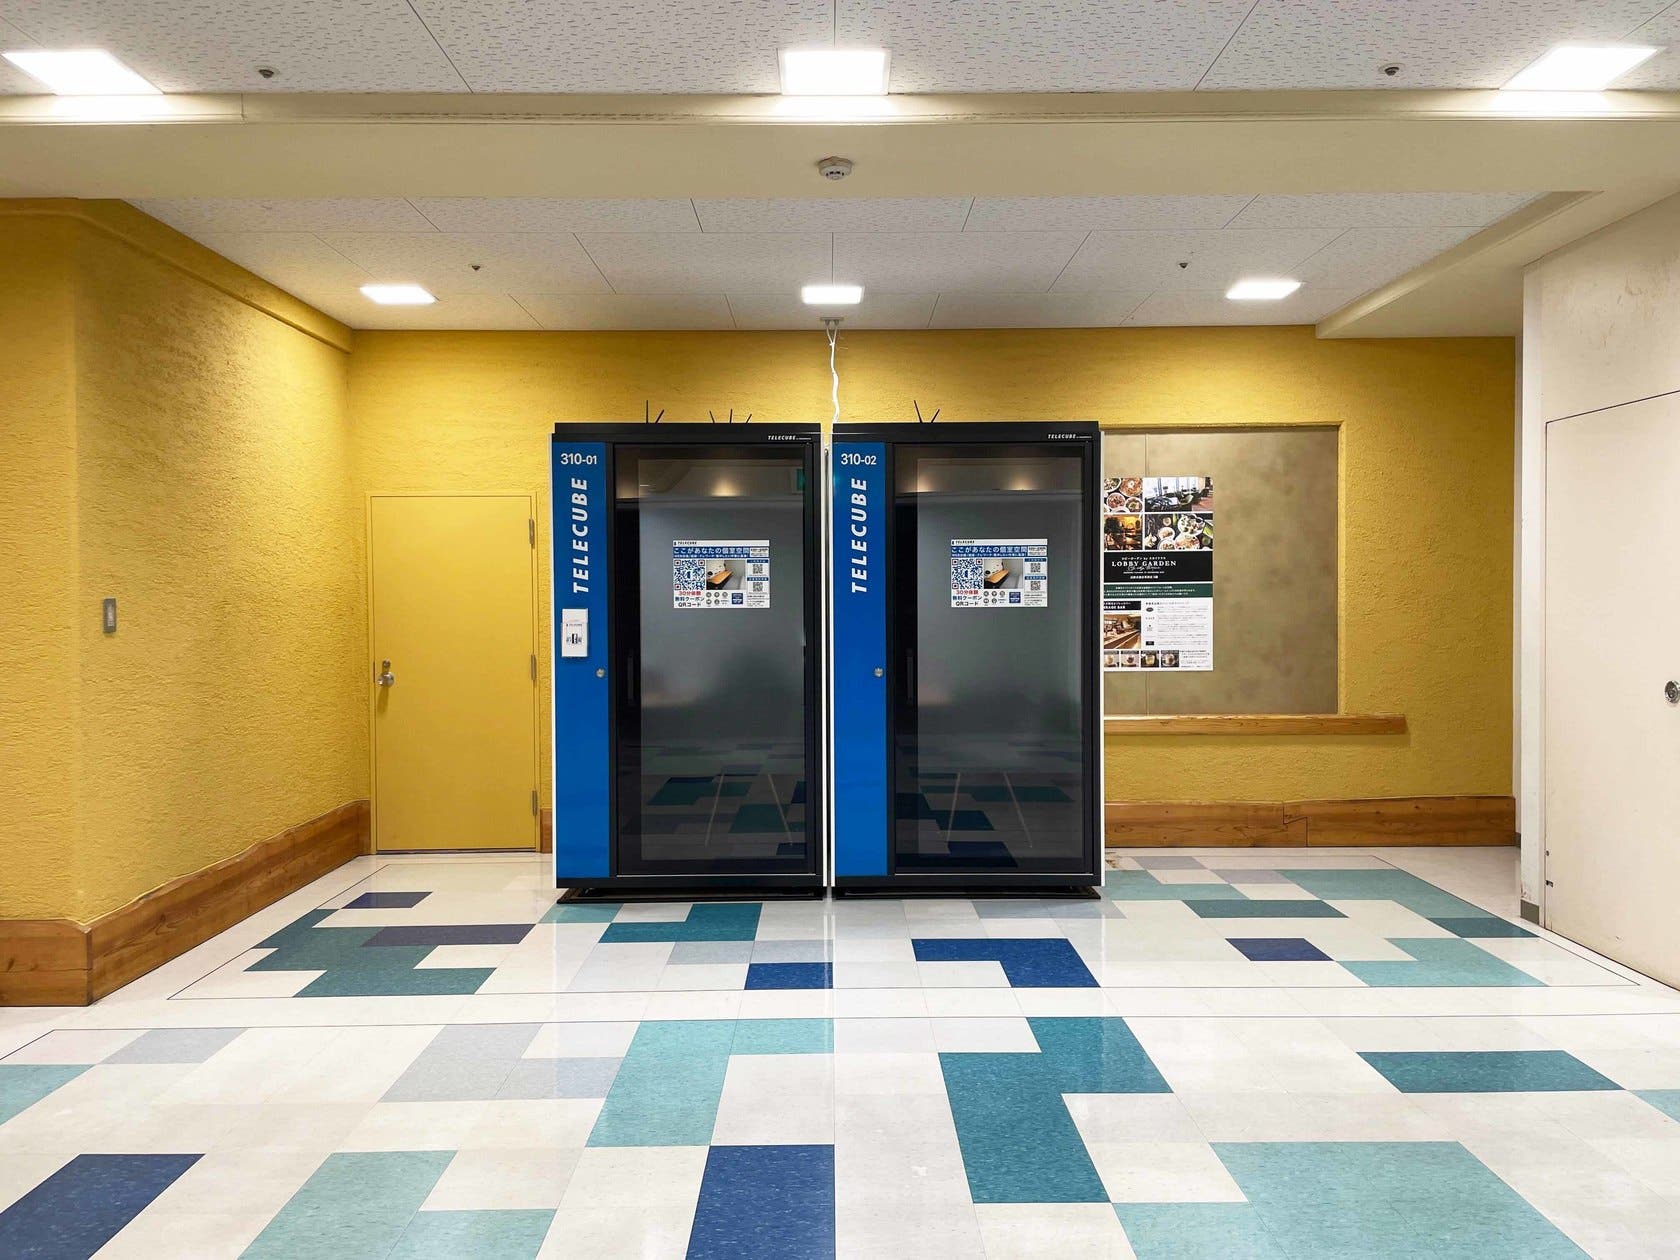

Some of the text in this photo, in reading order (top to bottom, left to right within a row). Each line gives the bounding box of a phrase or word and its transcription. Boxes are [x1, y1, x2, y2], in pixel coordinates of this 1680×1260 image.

[560, 453, 597, 465] 310-01
[840, 453, 877, 465] 310-02
[571, 477, 589, 594] TELECUBE
[851, 477, 868, 594] TELECUBE
